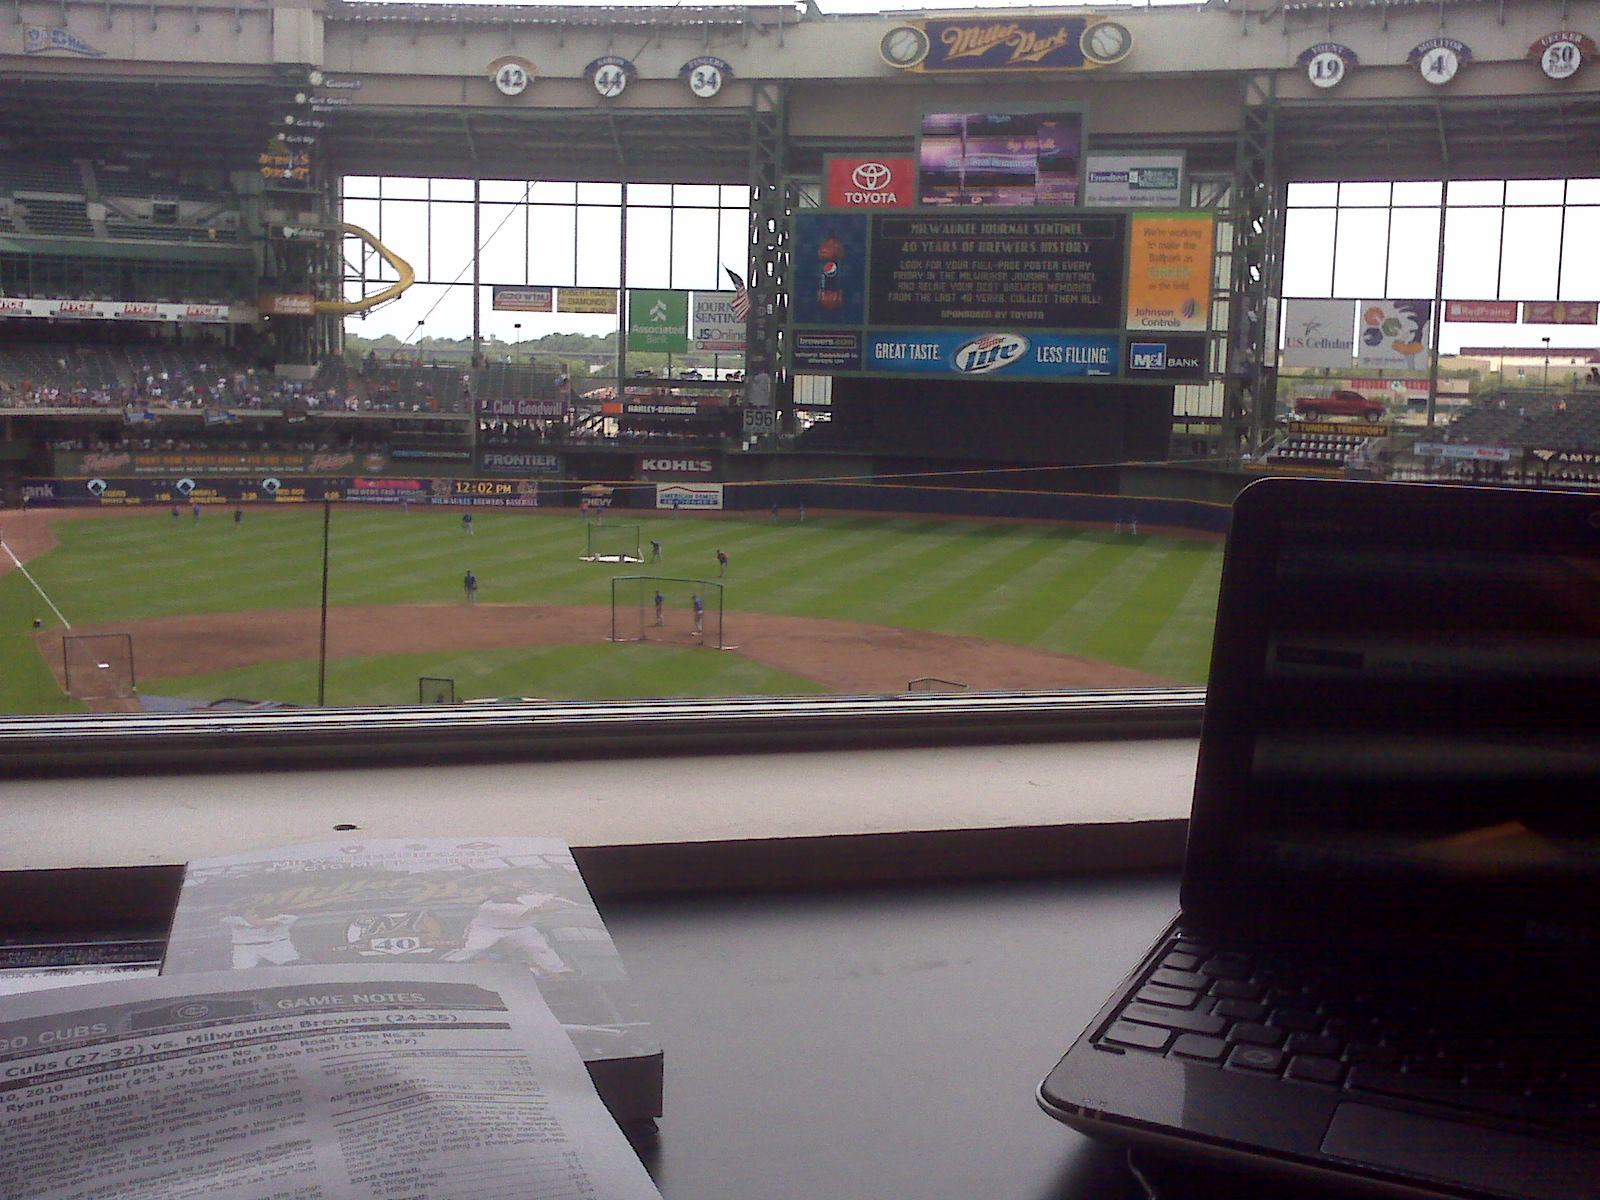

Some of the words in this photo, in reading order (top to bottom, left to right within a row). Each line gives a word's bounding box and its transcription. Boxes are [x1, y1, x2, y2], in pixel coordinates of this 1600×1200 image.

[941, 24, 1021, 61] Miller
[1005, 27, 1069, 64] Park
[1548, 46, 1574, 64] 50
[1313, 59, 1341, 80] 19
[1430, 55, 1444, 75] 4
[500, 69, 523, 87] 42
[598, 71, 622, 89] 44
[693, 71, 718, 90] 34
[845, 192, 896, 204] TOYOTA
[911, 223, 977, 235] MILWAUKEE
[981, 223, 1028, 235] JOURNAL
[1033, 223, 1083, 235] SENTINEL
[901, 242, 918, 253] 40
[921, 242, 958, 253] YEARS
[961, 242, 975, 253] OF
[978, 242, 1037, 253] BREWERS
[1040, 242, 1091, 253] HISTORY
[697, 302, 734, 312] JOURN
[1135, 308, 1174, 317] Johnson
[632, 325, 685, 334] Associated
[1141, 318, 1181, 327] Controls
[875, 343, 907, 359] GREAT
[1037, 346, 1062, 363] LESS
[1168, 358, 1199, 368] BANK
[494, 401, 515, 415] Club
[518, 401, 562, 416] Goodwill
[627, 405, 697, 415] HARLEY-DAVIDSON
[745, 411, 773, 426] 596
[484, 453, 557, 466] FRONTIER
[642, 459, 713, 472] KOHL'S
[22, 484, 54, 497] ank
[456, 482, 493, 494] 12:02
[496, 484, 512, 494] PM
[277, 995, 345, 1009] GAME
[352, 992, 426, 1004] NOTES
[38, 1022, 108, 1044] CUBS
[6, 1059, 58, 1077] Cubs
[64, 1044, 145, 1068] (27-32)
[151, 1040, 178, 1051] vs.
[186, 1023, 294, 1045] Milwaukee
[300, 1014, 380, 1028] Brewers
[386, 1013, 458, 1024] (24-35)
[26, 1084, 63, 1098] 2010
[87, 1071, 128, 1085] Miller
[133, 1064, 165, 1076] Park
[188, 1053, 229, 1066] Game
[6, 1099, 44, 1113] Ryan
[50, 1083, 122, 1104] Dempster
